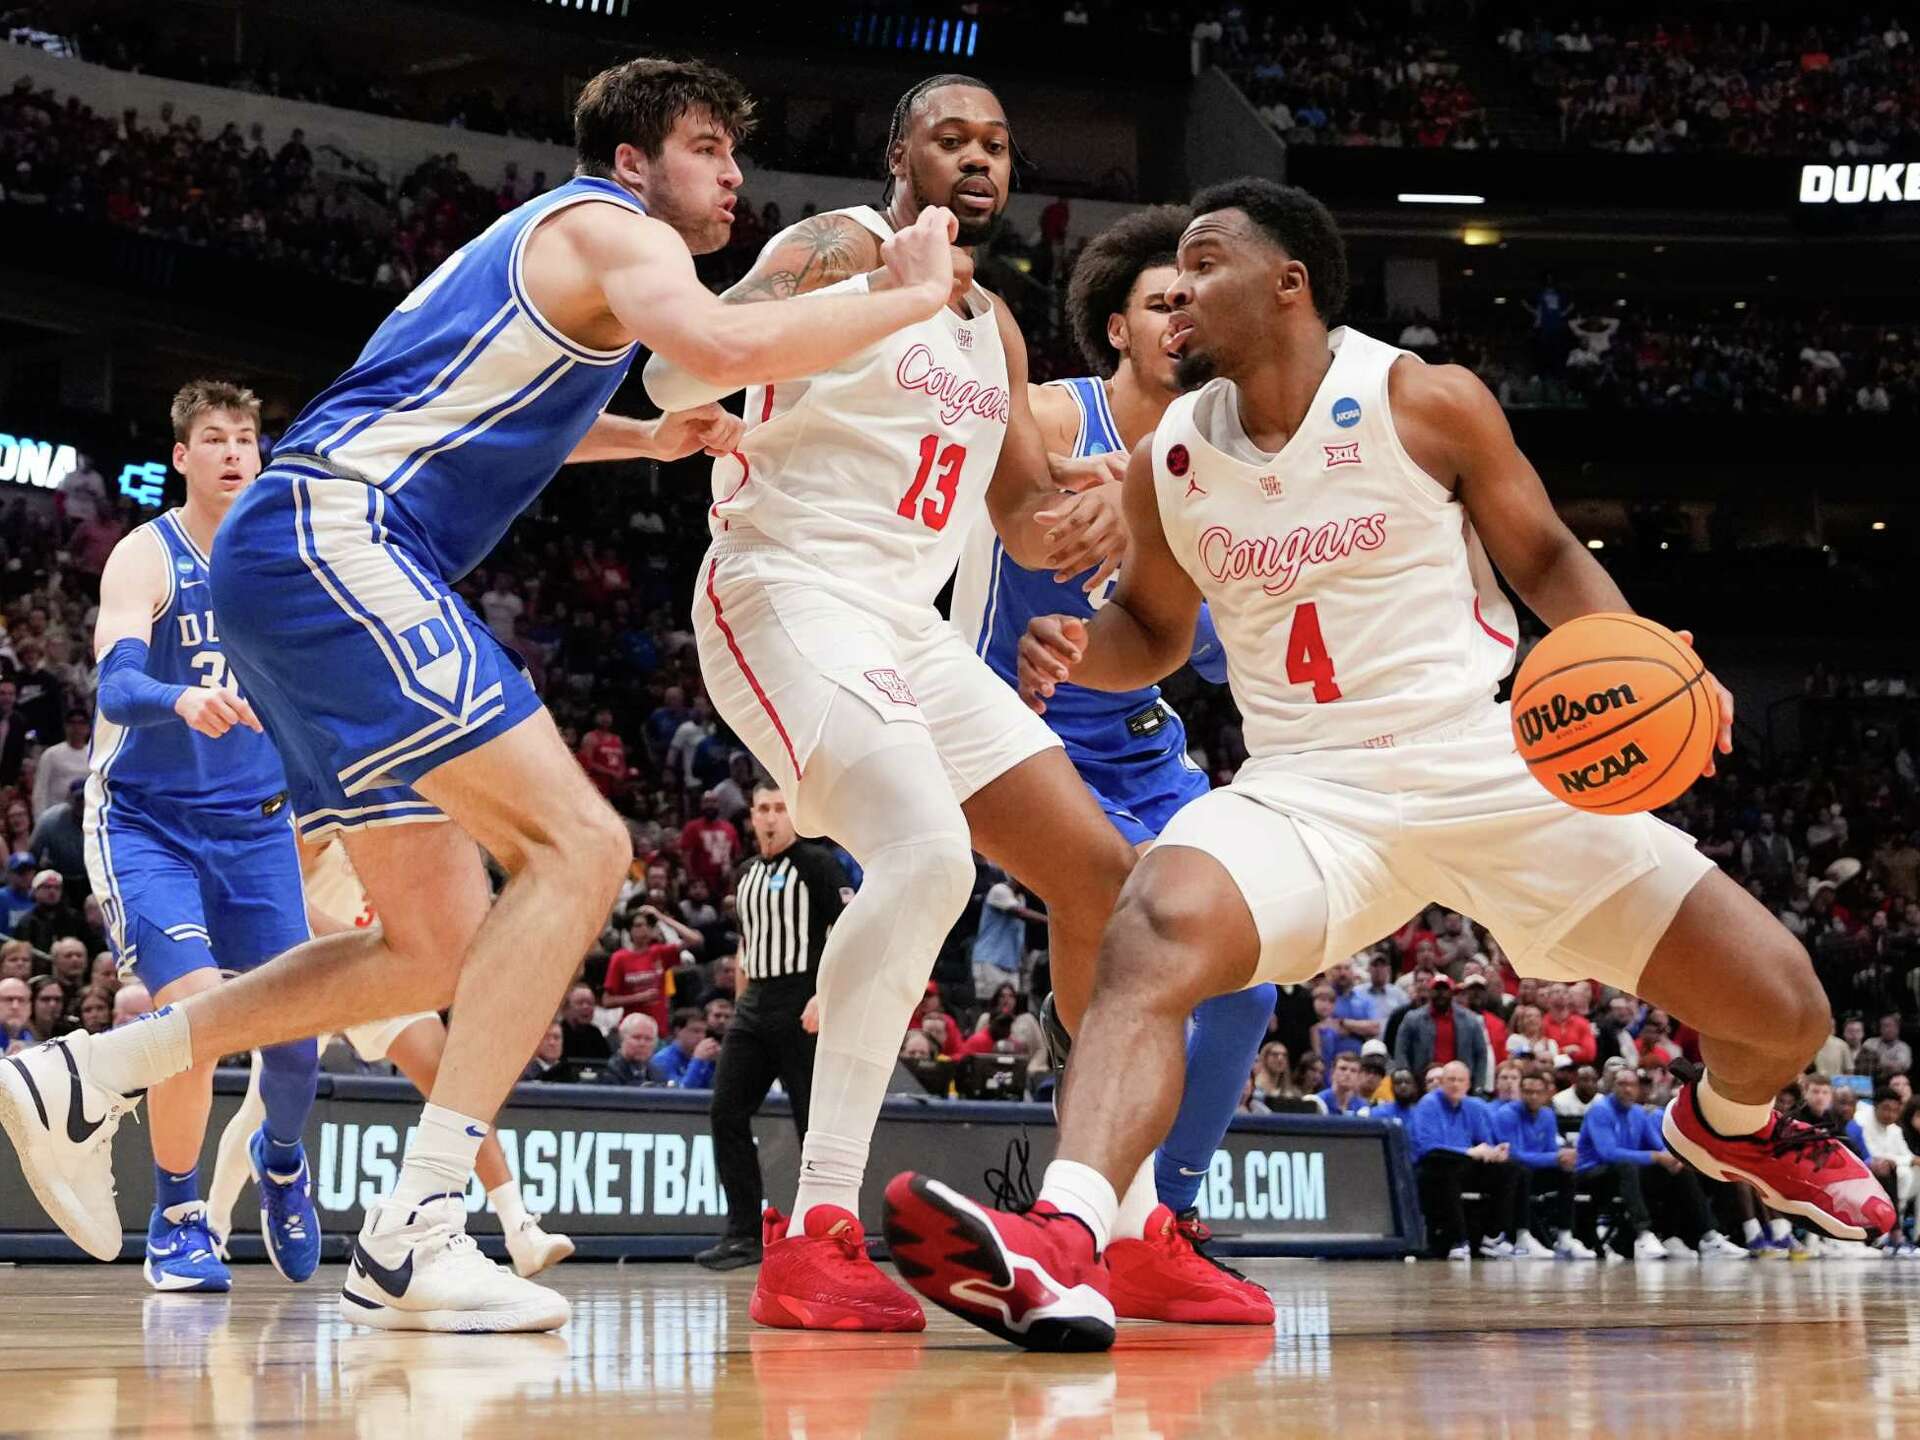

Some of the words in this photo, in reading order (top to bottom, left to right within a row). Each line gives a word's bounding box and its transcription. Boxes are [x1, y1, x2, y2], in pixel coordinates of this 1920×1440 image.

[1799, 163, 1920, 203] DUKE
[897, 434, 967, 532] 13
[1199, 513, 1386, 596] Cougars
[191, 651, 240, 690] 3
[1285, 601, 1342, 704] 4
[1517, 683, 1638, 746] Wilson
[1557, 741, 1648, 793] NCAA
